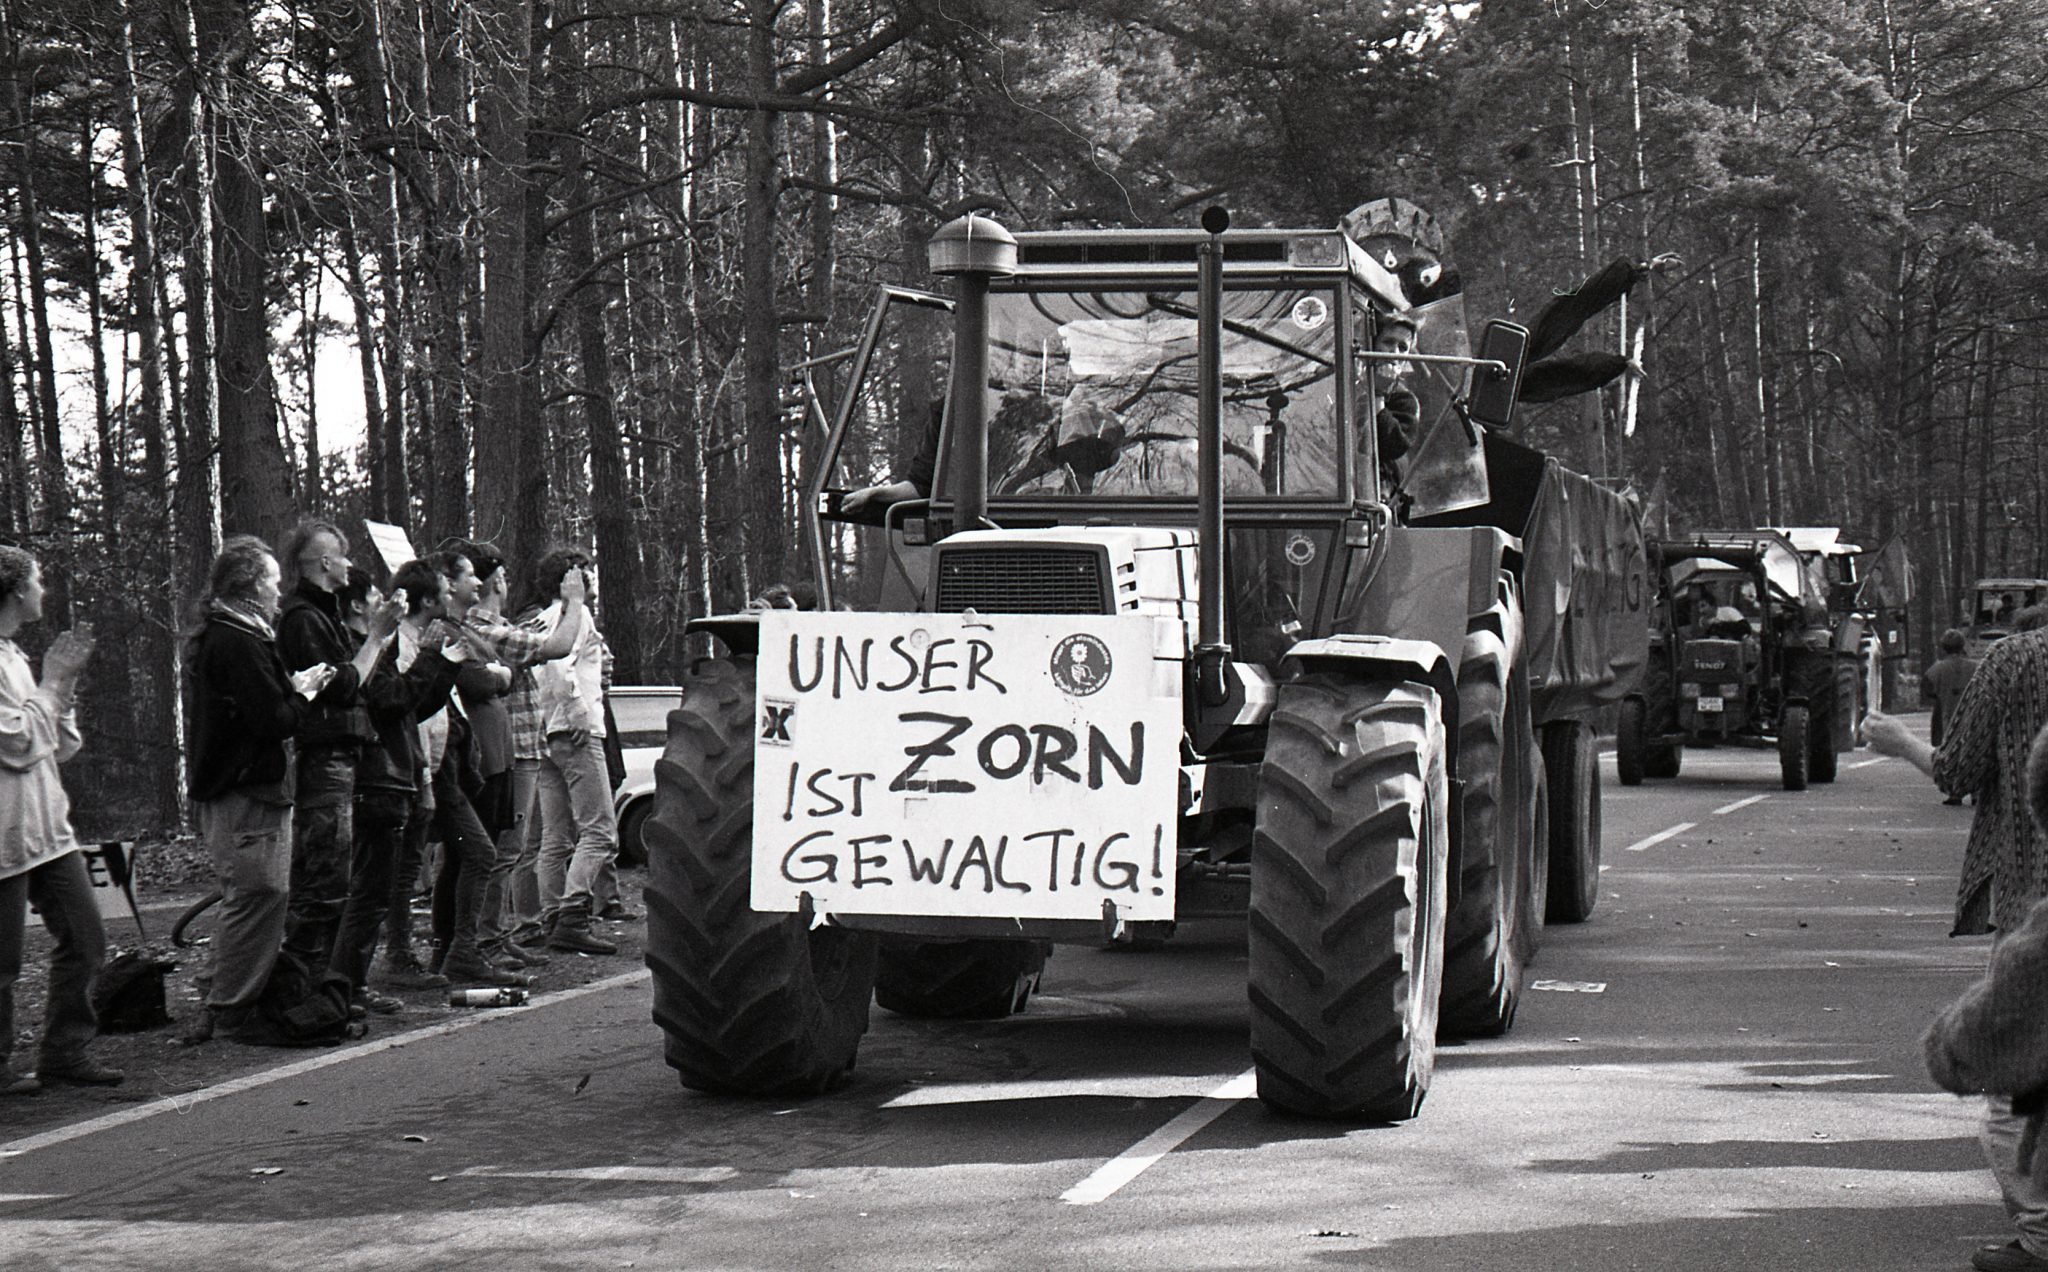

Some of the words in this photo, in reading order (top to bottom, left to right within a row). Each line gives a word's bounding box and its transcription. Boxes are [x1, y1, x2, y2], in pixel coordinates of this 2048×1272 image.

[788, 633, 1007, 699] UNSER
[888, 711, 1145, 793] ZORN
[782, 761, 876, 822] IST
[780, 824, 1165, 897] GEWALTIG!
